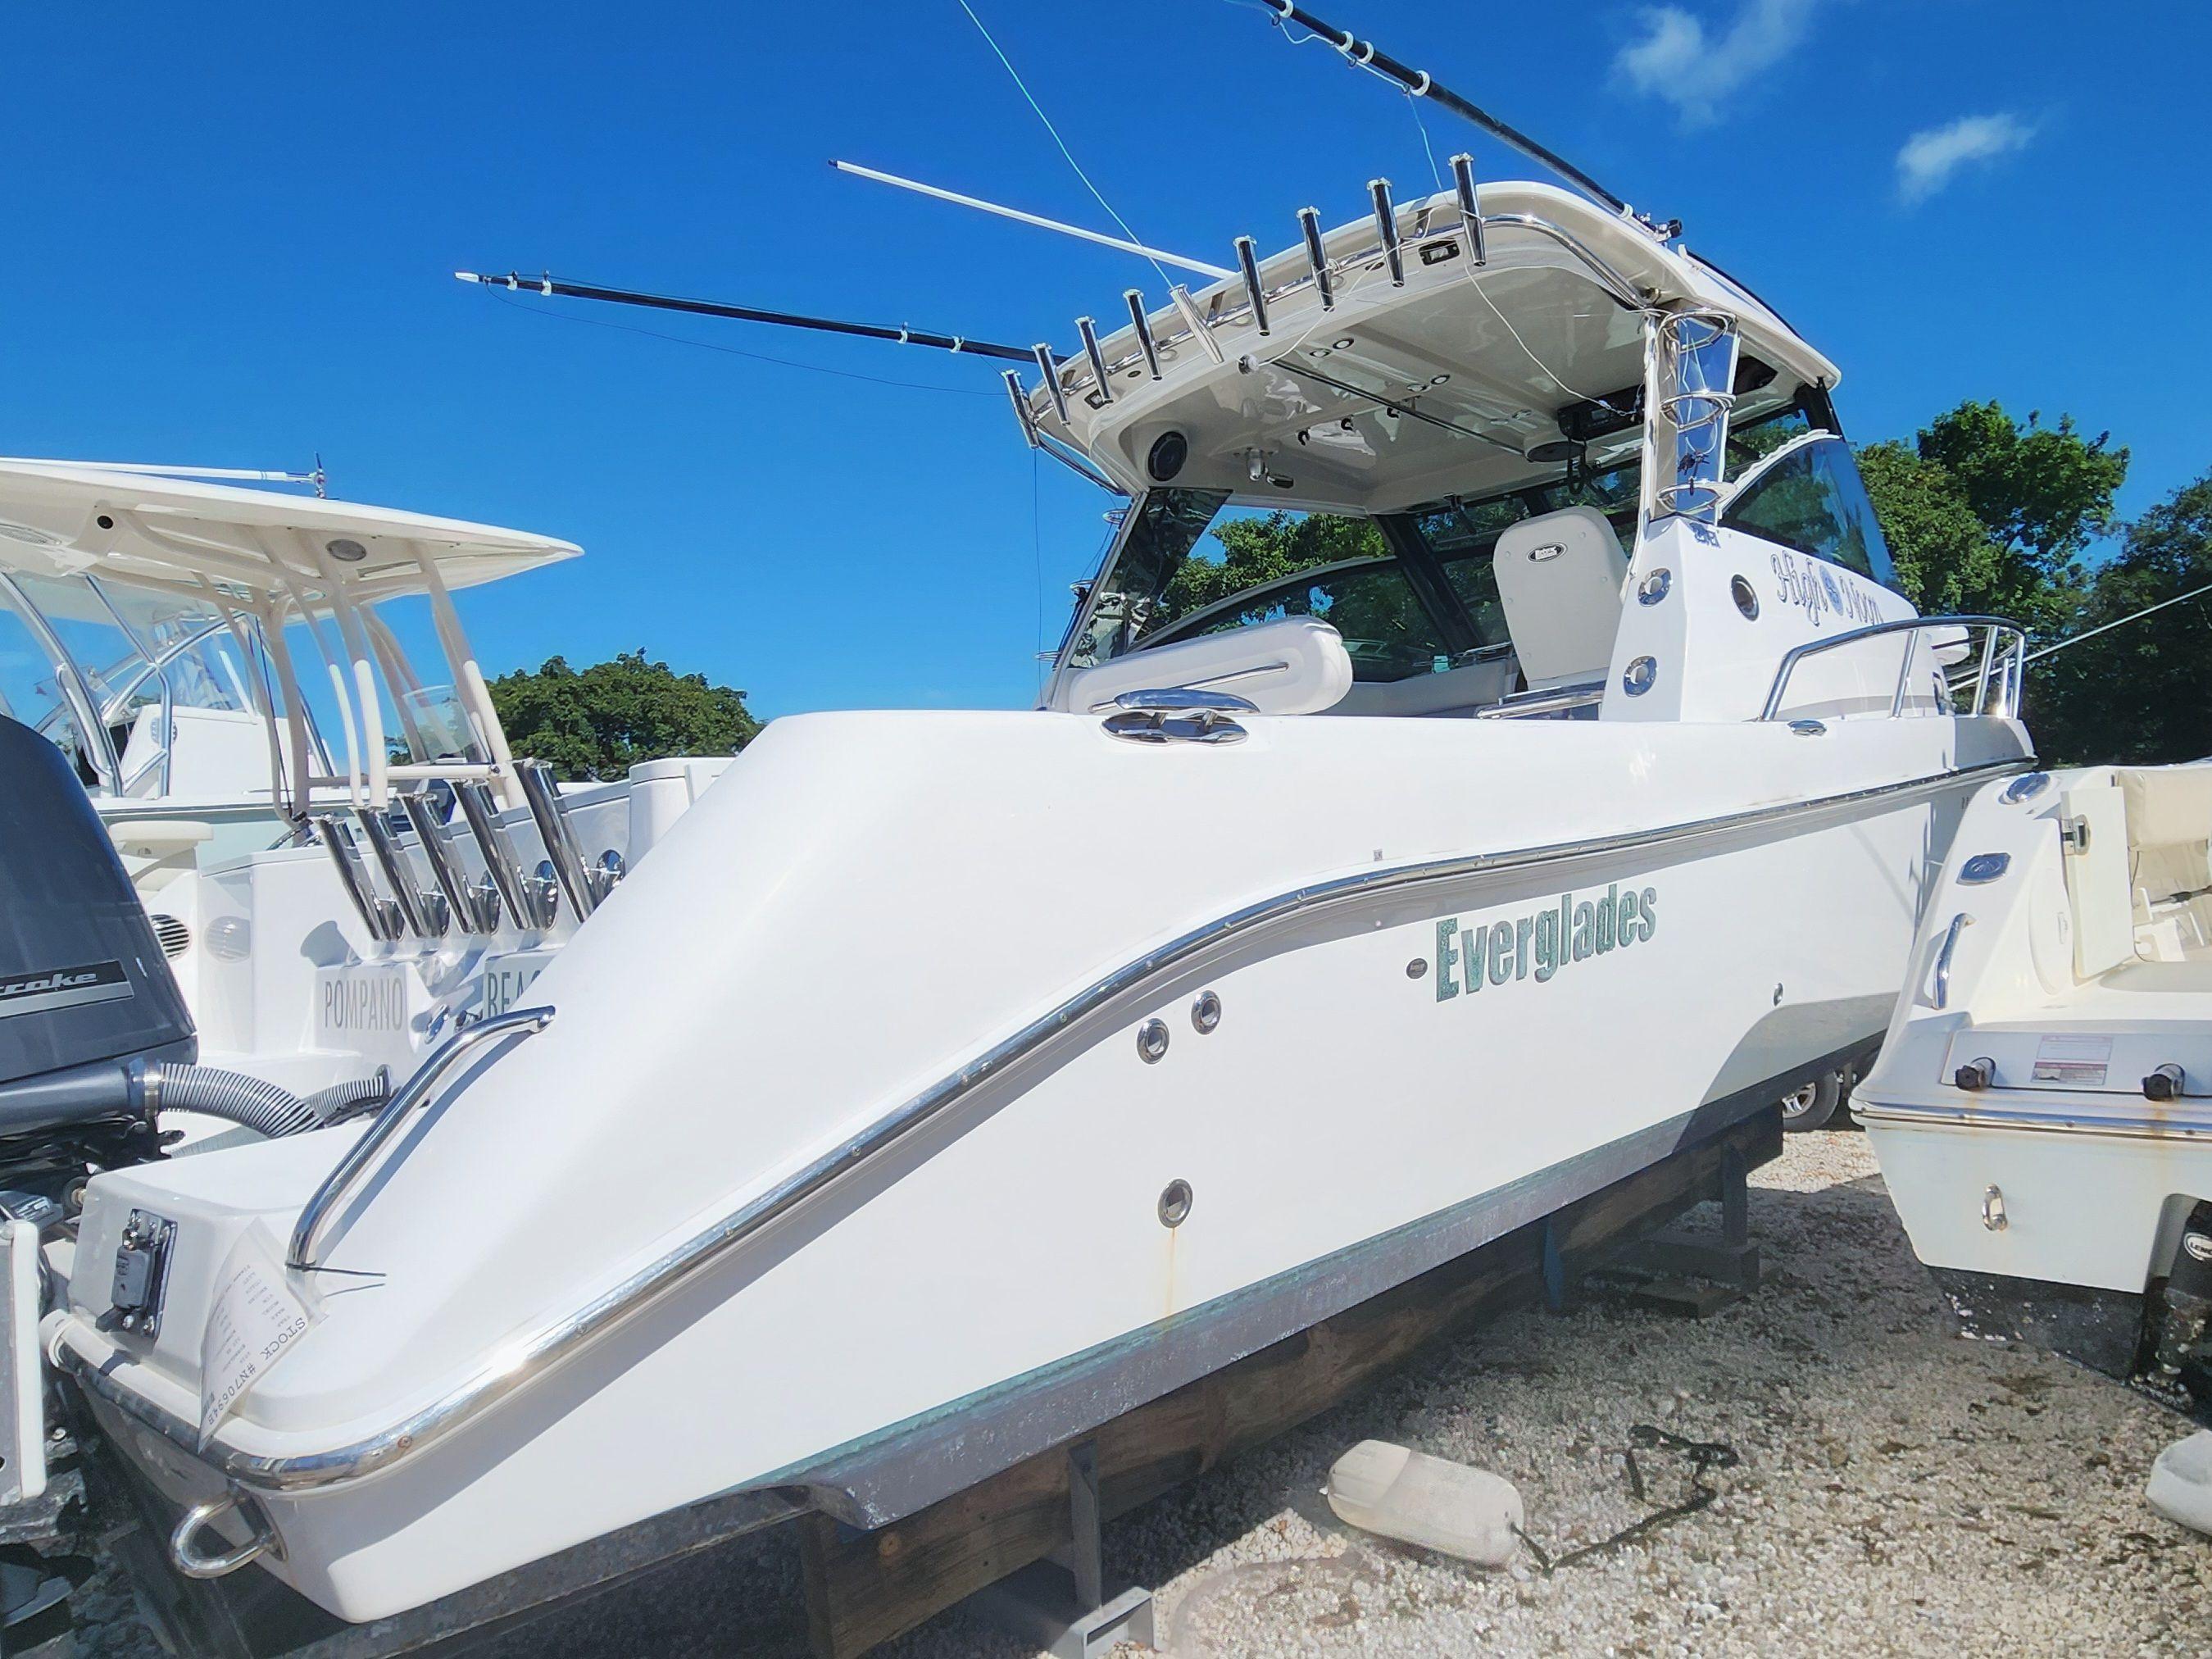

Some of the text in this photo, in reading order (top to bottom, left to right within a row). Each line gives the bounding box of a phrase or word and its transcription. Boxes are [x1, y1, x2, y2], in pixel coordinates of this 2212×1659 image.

[1770, 549, 1828, 627] High
[1436, 884, 1657, 1002] Everglades
[0, 973, 98, 995] roke
[325, 970, 541, 1030] POMPANO BEA
[260, 1316, 307, 1361] STOCK
